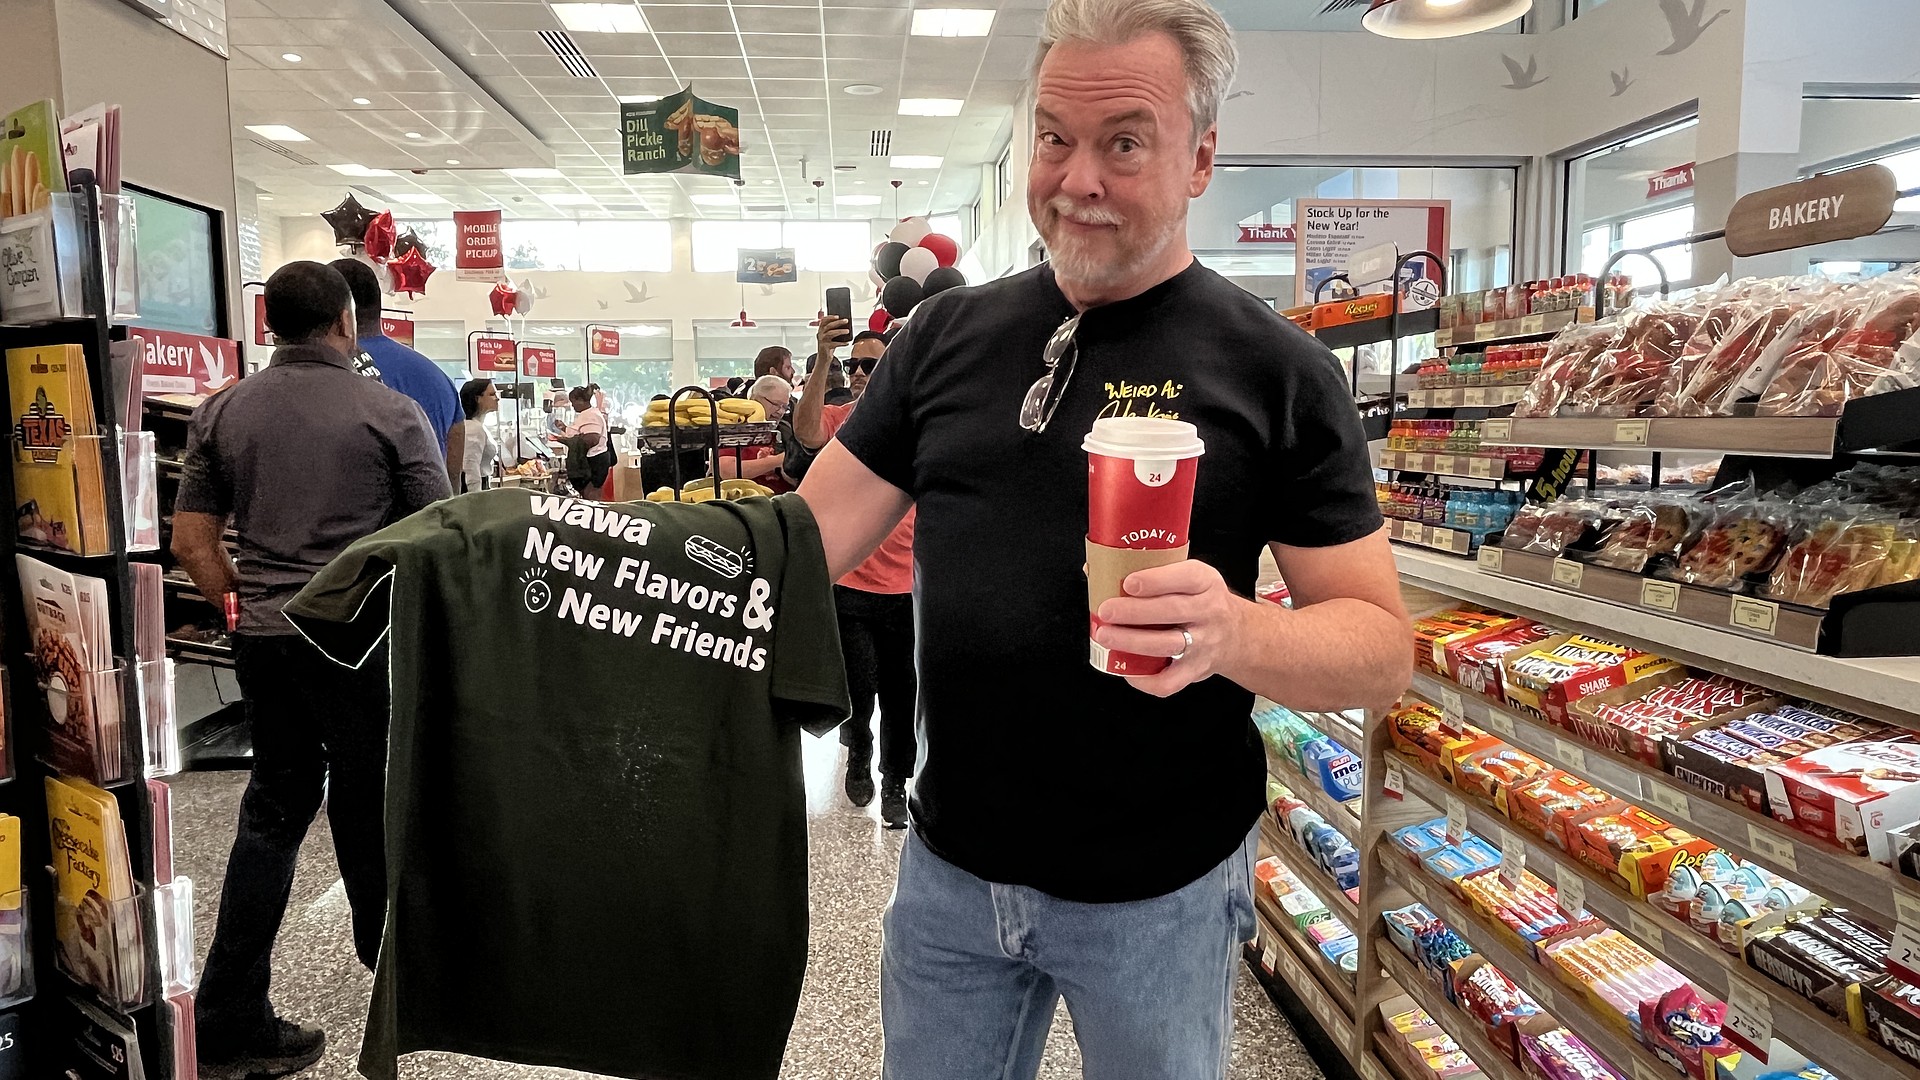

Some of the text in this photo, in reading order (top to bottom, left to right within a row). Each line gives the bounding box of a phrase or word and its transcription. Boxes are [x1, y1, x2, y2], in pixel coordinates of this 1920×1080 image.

[626, 118, 648, 132] Dill
[626, 131, 663, 147] Pickle
[627, 146, 666, 161] Ranch
[1652, 170, 1688, 191] Thank
[1307, 207, 1390, 220] Stock Up for the
[1768, 194, 1845, 230] BAKERY
[463, 223, 498, 234] MOBILE
[1307, 220, 1359, 231] New Year!
[1247, 227, 1288, 239] Thank
[466, 236, 497, 246] ORDER
[465, 249, 498, 258] PICKUP
[383, 322, 396, 332] Up
[480, 341, 503, 350] Pick Up
[133, 334, 194, 374] akery
[22, 419, 65, 446] TEXAS
[1149, 473, 1161, 482] 24
[1120, 528, 1177, 546] TODAY IS
[523, 526, 775, 633] New Flavors &
[557, 588, 768, 672] New Friends
[1114, 661, 1127, 671] 24
[1578, 675, 1612, 696] SHARE
